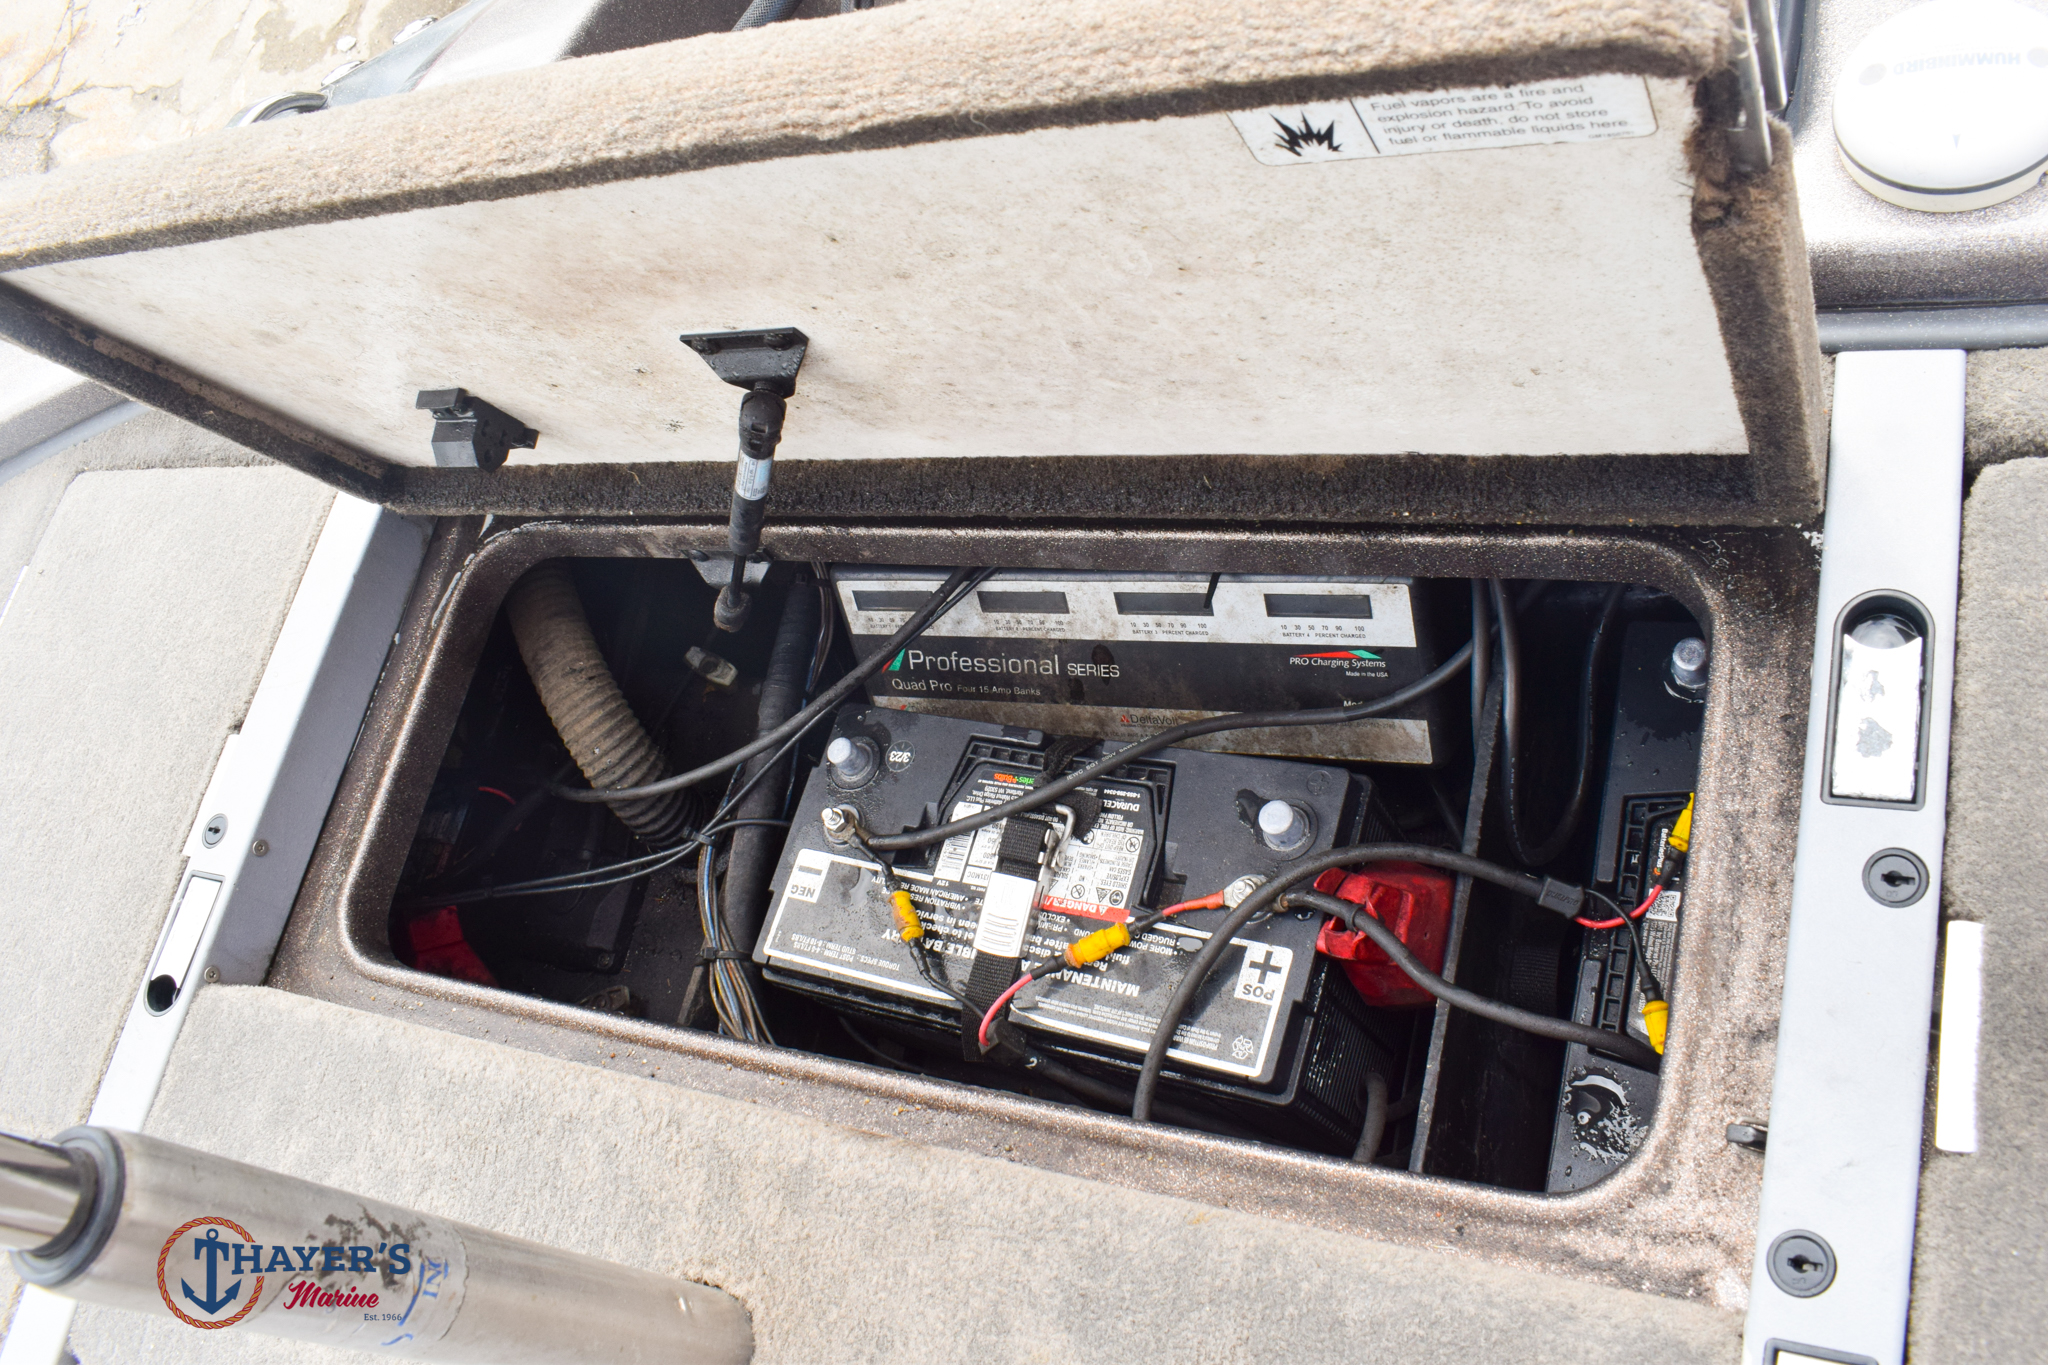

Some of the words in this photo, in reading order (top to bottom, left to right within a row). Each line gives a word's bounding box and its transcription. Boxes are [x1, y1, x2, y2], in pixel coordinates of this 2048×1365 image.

[1893, 51, 2021, 76] HUMMINBIRD
[1370, 97, 1406, 112] Fuel
[1412, 95, 1466, 109] vapors
[1471, 91, 1498, 103] are
[1504, 90, 1514, 99] a
[1519, 87, 1546, 98] fire
[1552, 84, 1584, 96] and
[1377, 106, 1453, 125] explosion
[1524, 100, 1542, 111] To
[1549, 96, 1594, 109] avoid
[1383, 122, 1425, 138] injury
[1432, 121, 1447, 131] or
[1508, 113, 1529, 125] do
[1534, 111, 1560, 123] not
[1566, 107, 1608, 120] store
[1389, 134, 1418, 147] fuel
[1423, 133, 1437, 143] or
[1442, 125, 1526, 142] flammable
[1531, 121, 1586, 136] liquids
[907, 650, 1060, 676] Professional
[1067, 663, 1120, 678] SERIES
[1289, 657, 1309, 665] PRO
[1311, 658, 1350, 668] Charging
[1352, 659, 1386, 669] Systems
[891, 678, 926, 691] Quad
[930, 680, 953, 692] Pro
[956, 685, 976, 693] Four
[979, 685, 989, 694] 15
[992, 686, 1012, 696] Amp
[1013, 687, 1041, 696] Banks
[1130, 714, 1178, 726] DeltaVolt
[889, 750, 911, 763] 3/23
[1103, 799, 1140, 812] DURACEL
[1656, 828, 1669, 868] BatteriesPlus
[790, 883, 816, 899] NEG
[910, 884, 930, 896] MADE
[930, 888, 965, 902] AMERICAN
[925, 895, 961, 910] VIBRATION
[915, 909, 945, 923] servic
[946, 916, 957, 927] in
[920, 920, 950, 935] check
[952, 928, 963, 939] to
[1044, 938, 1069, 950] after
[1141, 932, 1176, 947] RUGGED
[842, 945, 857, 956] STUD
[1148, 944, 1173, 956] MORE
[839, 952, 855, 963] POST
[878, 959, 900, 972] TORQUE
[1242, 983, 1276, 1001] POS
